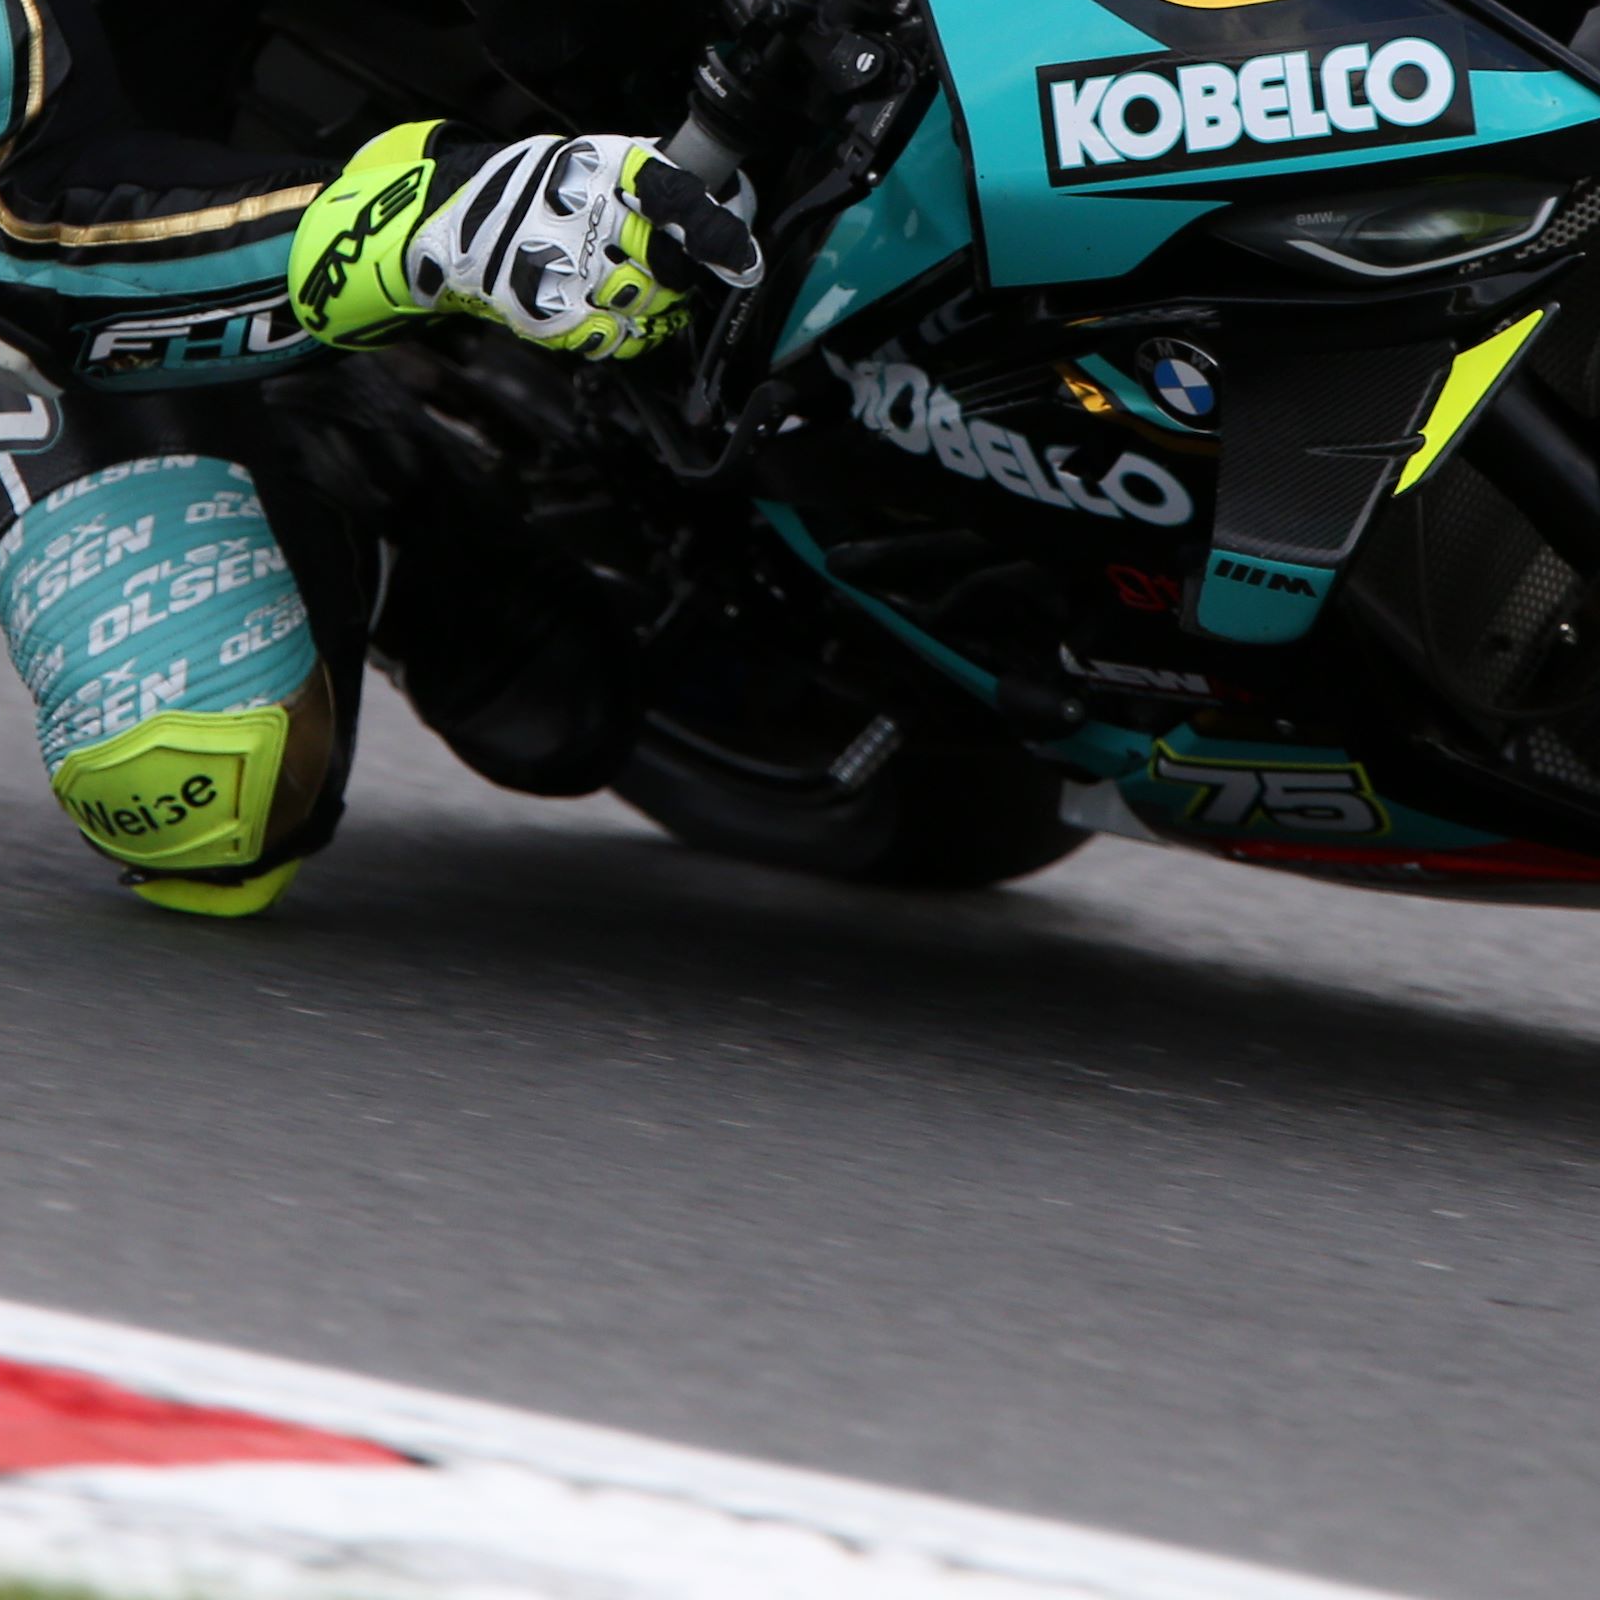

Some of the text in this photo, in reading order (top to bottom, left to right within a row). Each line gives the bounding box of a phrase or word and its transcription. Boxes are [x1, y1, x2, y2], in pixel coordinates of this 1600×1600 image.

[1050, 36, 1456, 169] KOBELCO
[87, 545, 288, 657] OLSEN
[68, 774, 218, 838] Weise
[1149, 738, 1392, 835] 75
